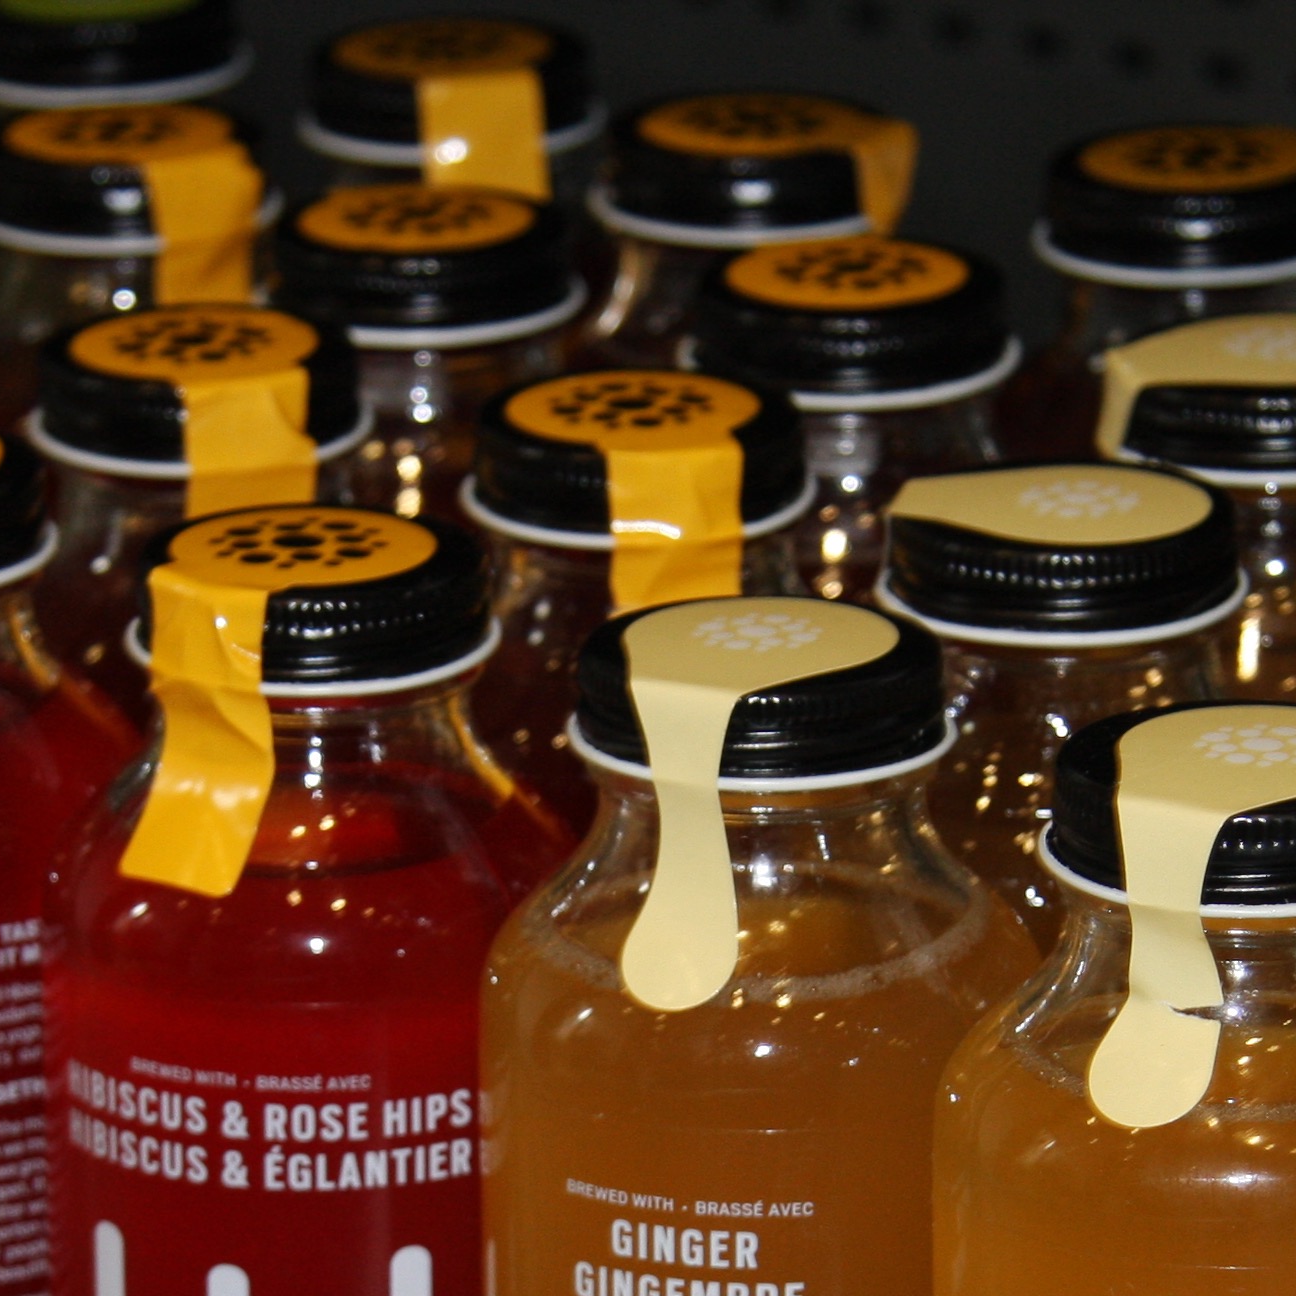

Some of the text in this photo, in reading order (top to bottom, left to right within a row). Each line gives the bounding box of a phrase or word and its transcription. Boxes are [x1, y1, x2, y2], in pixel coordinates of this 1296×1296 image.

[67, 1057, 207, 1136] HIBISCUS
[220, 1100, 249, 1140] &
[263, 1103, 369, 1142] ROSE
[382, 1088, 472, 1138] HIPS
[68, 1106, 472, 1192] HIBISCUS & ÉGLANTIER
[566, 1178, 814, 1217] BREWED WITH BRASSÉ AVEC
[610, 1218, 759, 1269] GINGER
